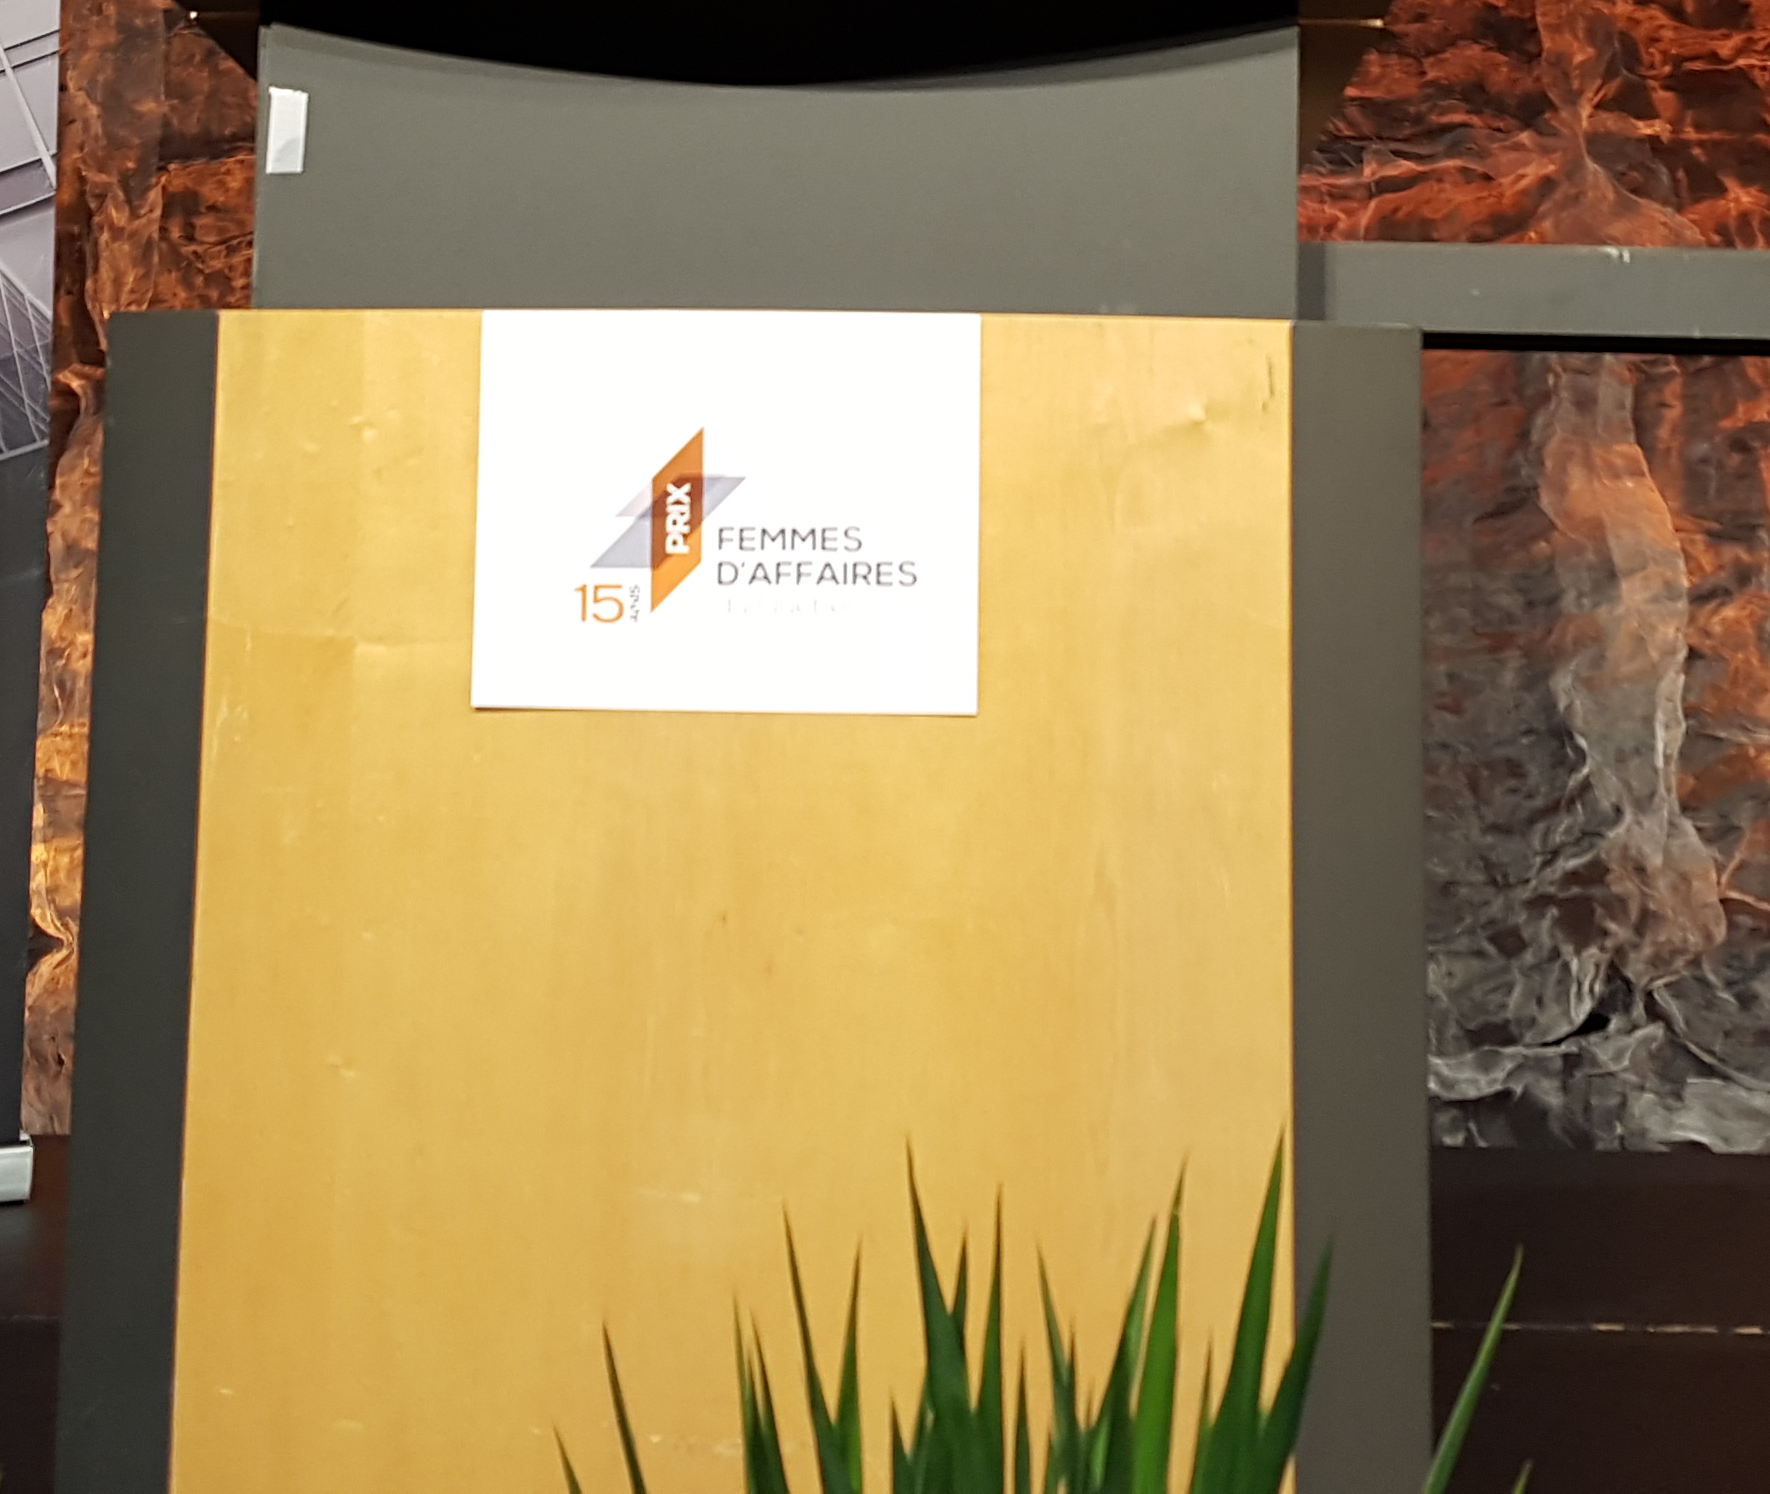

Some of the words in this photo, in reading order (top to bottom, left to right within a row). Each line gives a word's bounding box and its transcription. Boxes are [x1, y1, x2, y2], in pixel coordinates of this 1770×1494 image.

[664, 482, 692, 555] PRIX
[716, 525, 865, 554] FEMMES
[716, 559, 920, 588] D'AFFAIRES
[573, 582, 626, 625] 15
